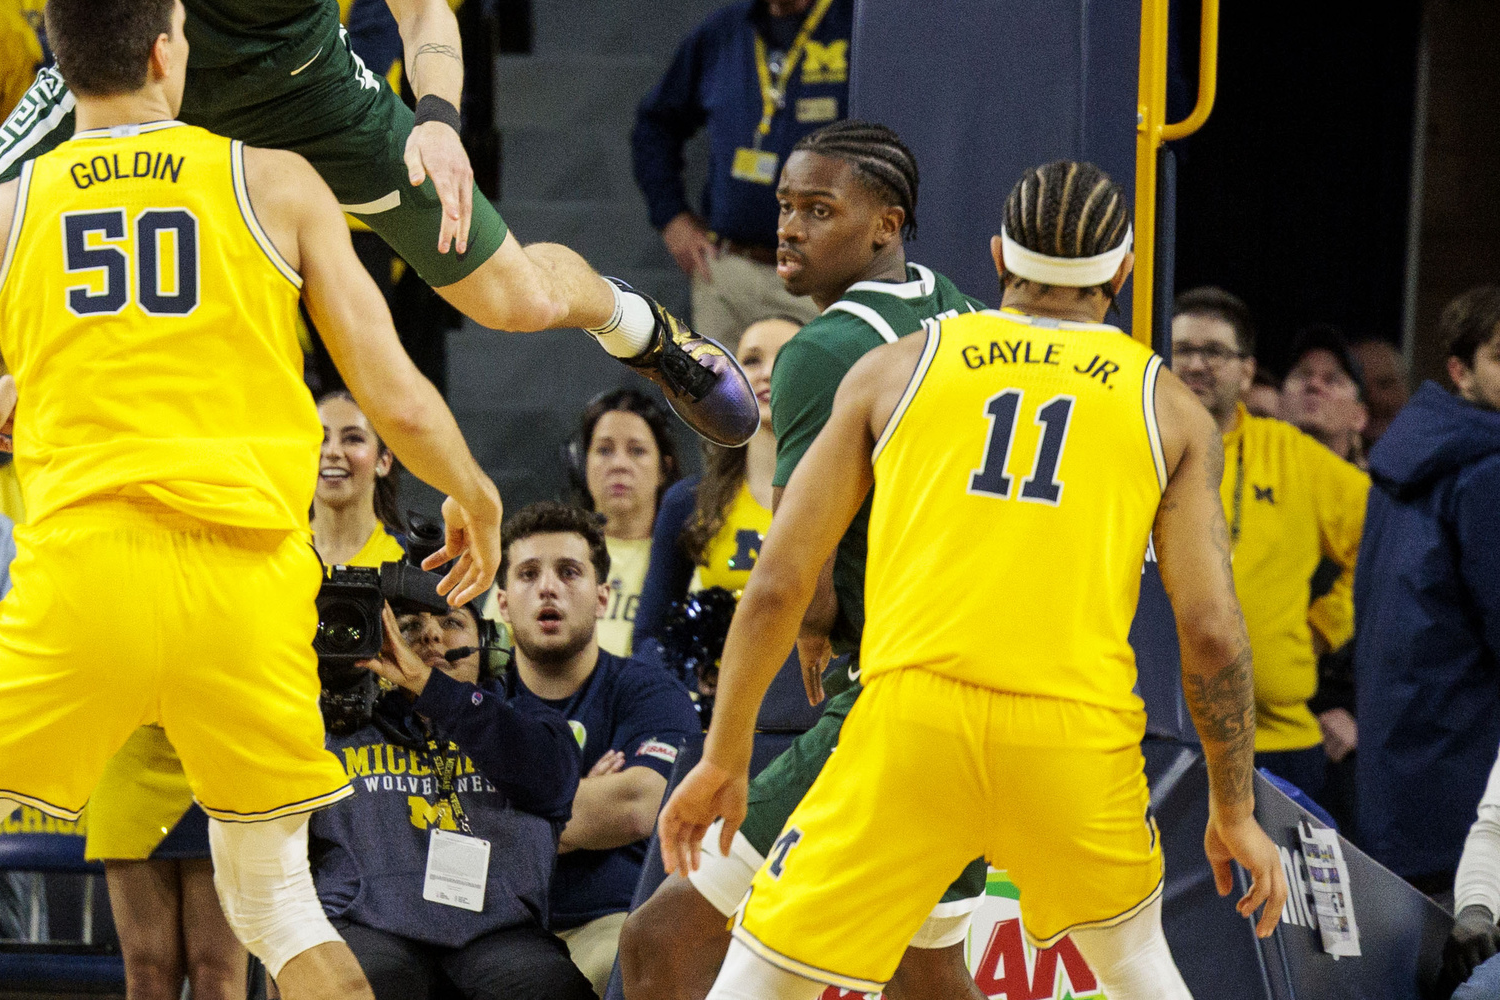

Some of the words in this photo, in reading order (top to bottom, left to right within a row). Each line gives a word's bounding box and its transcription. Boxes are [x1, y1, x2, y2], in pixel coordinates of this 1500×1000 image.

[70, 151, 185, 190] GOLDIN
[61, 206, 201, 318] 50
[961, 341, 1064, 371] GAYLE
[1074, 352, 1120, 391] JR.
[968, 388, 1078, 507] 11
[364, 775, 497, 796] WOLVENE
